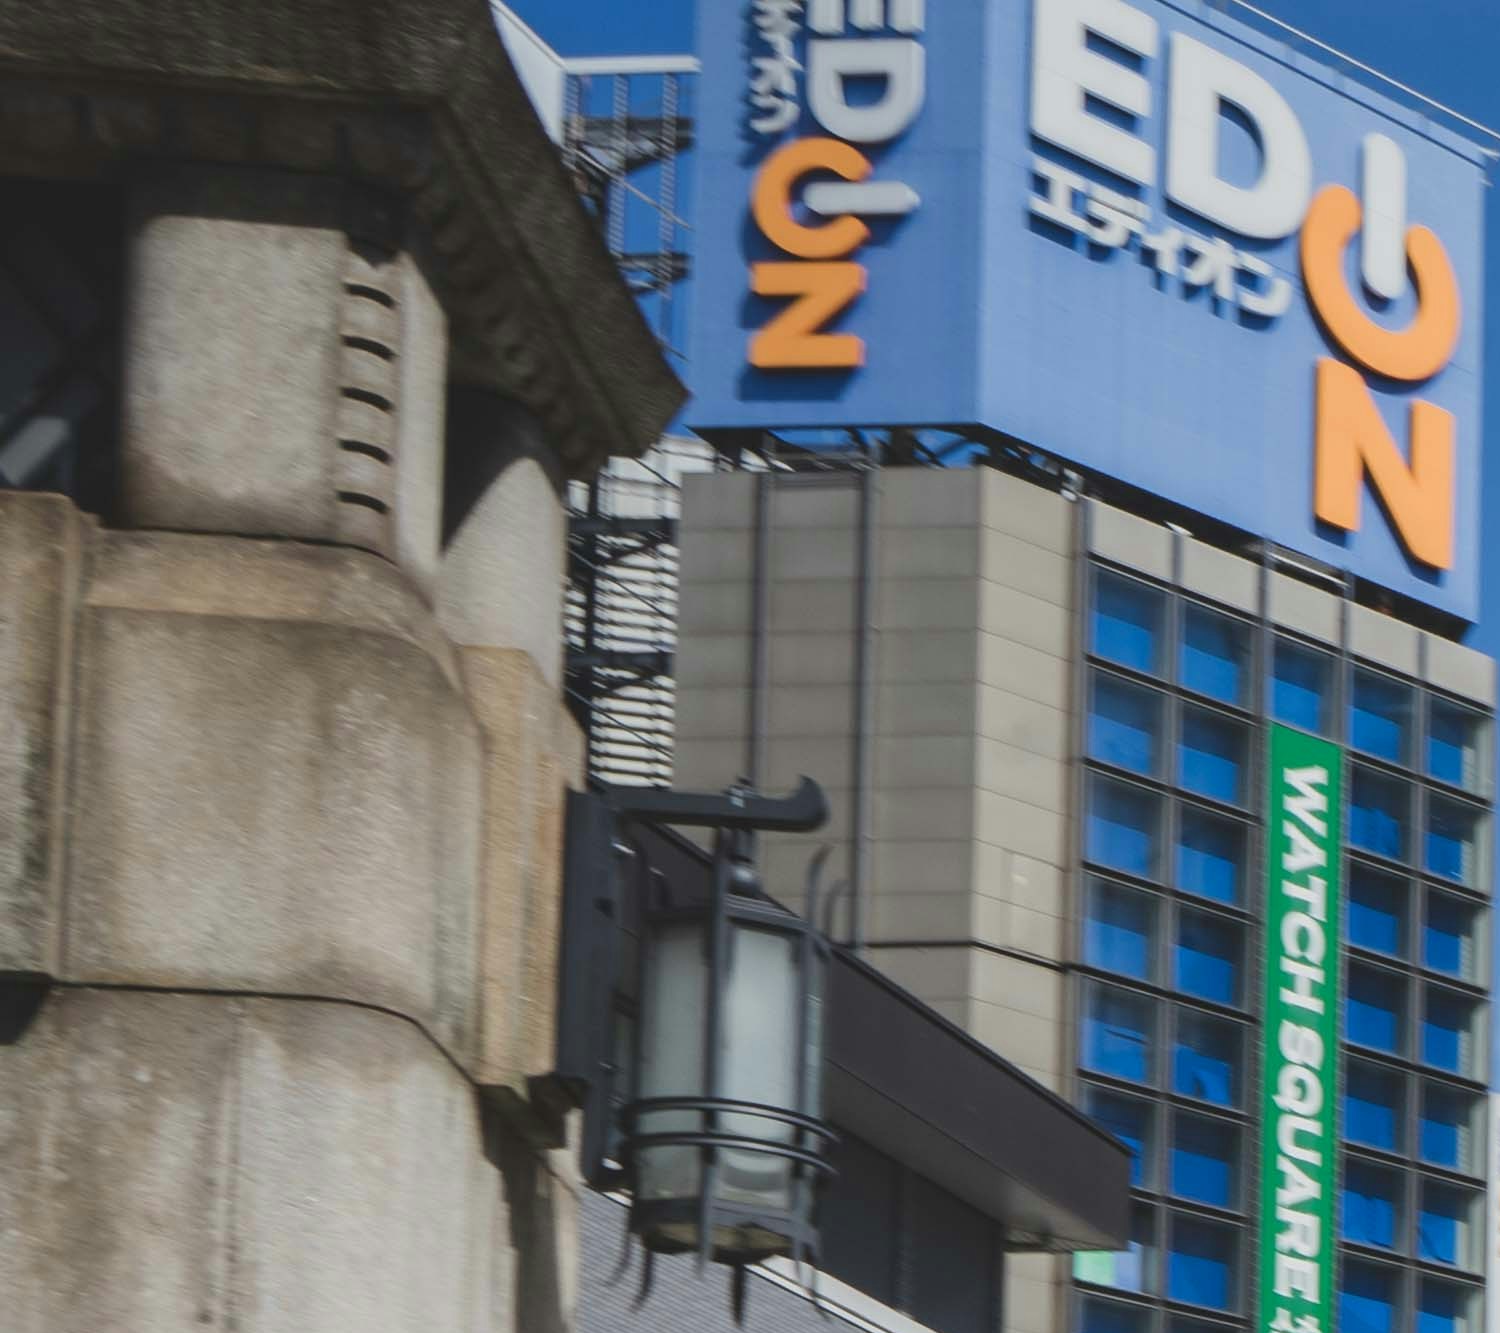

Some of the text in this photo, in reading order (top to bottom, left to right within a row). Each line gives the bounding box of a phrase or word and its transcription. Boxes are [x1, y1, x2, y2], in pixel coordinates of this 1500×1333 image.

[1028, 152, 1292, 317] エディオン
[1272, 763, 1329, 1304] WATCH SQUARE
